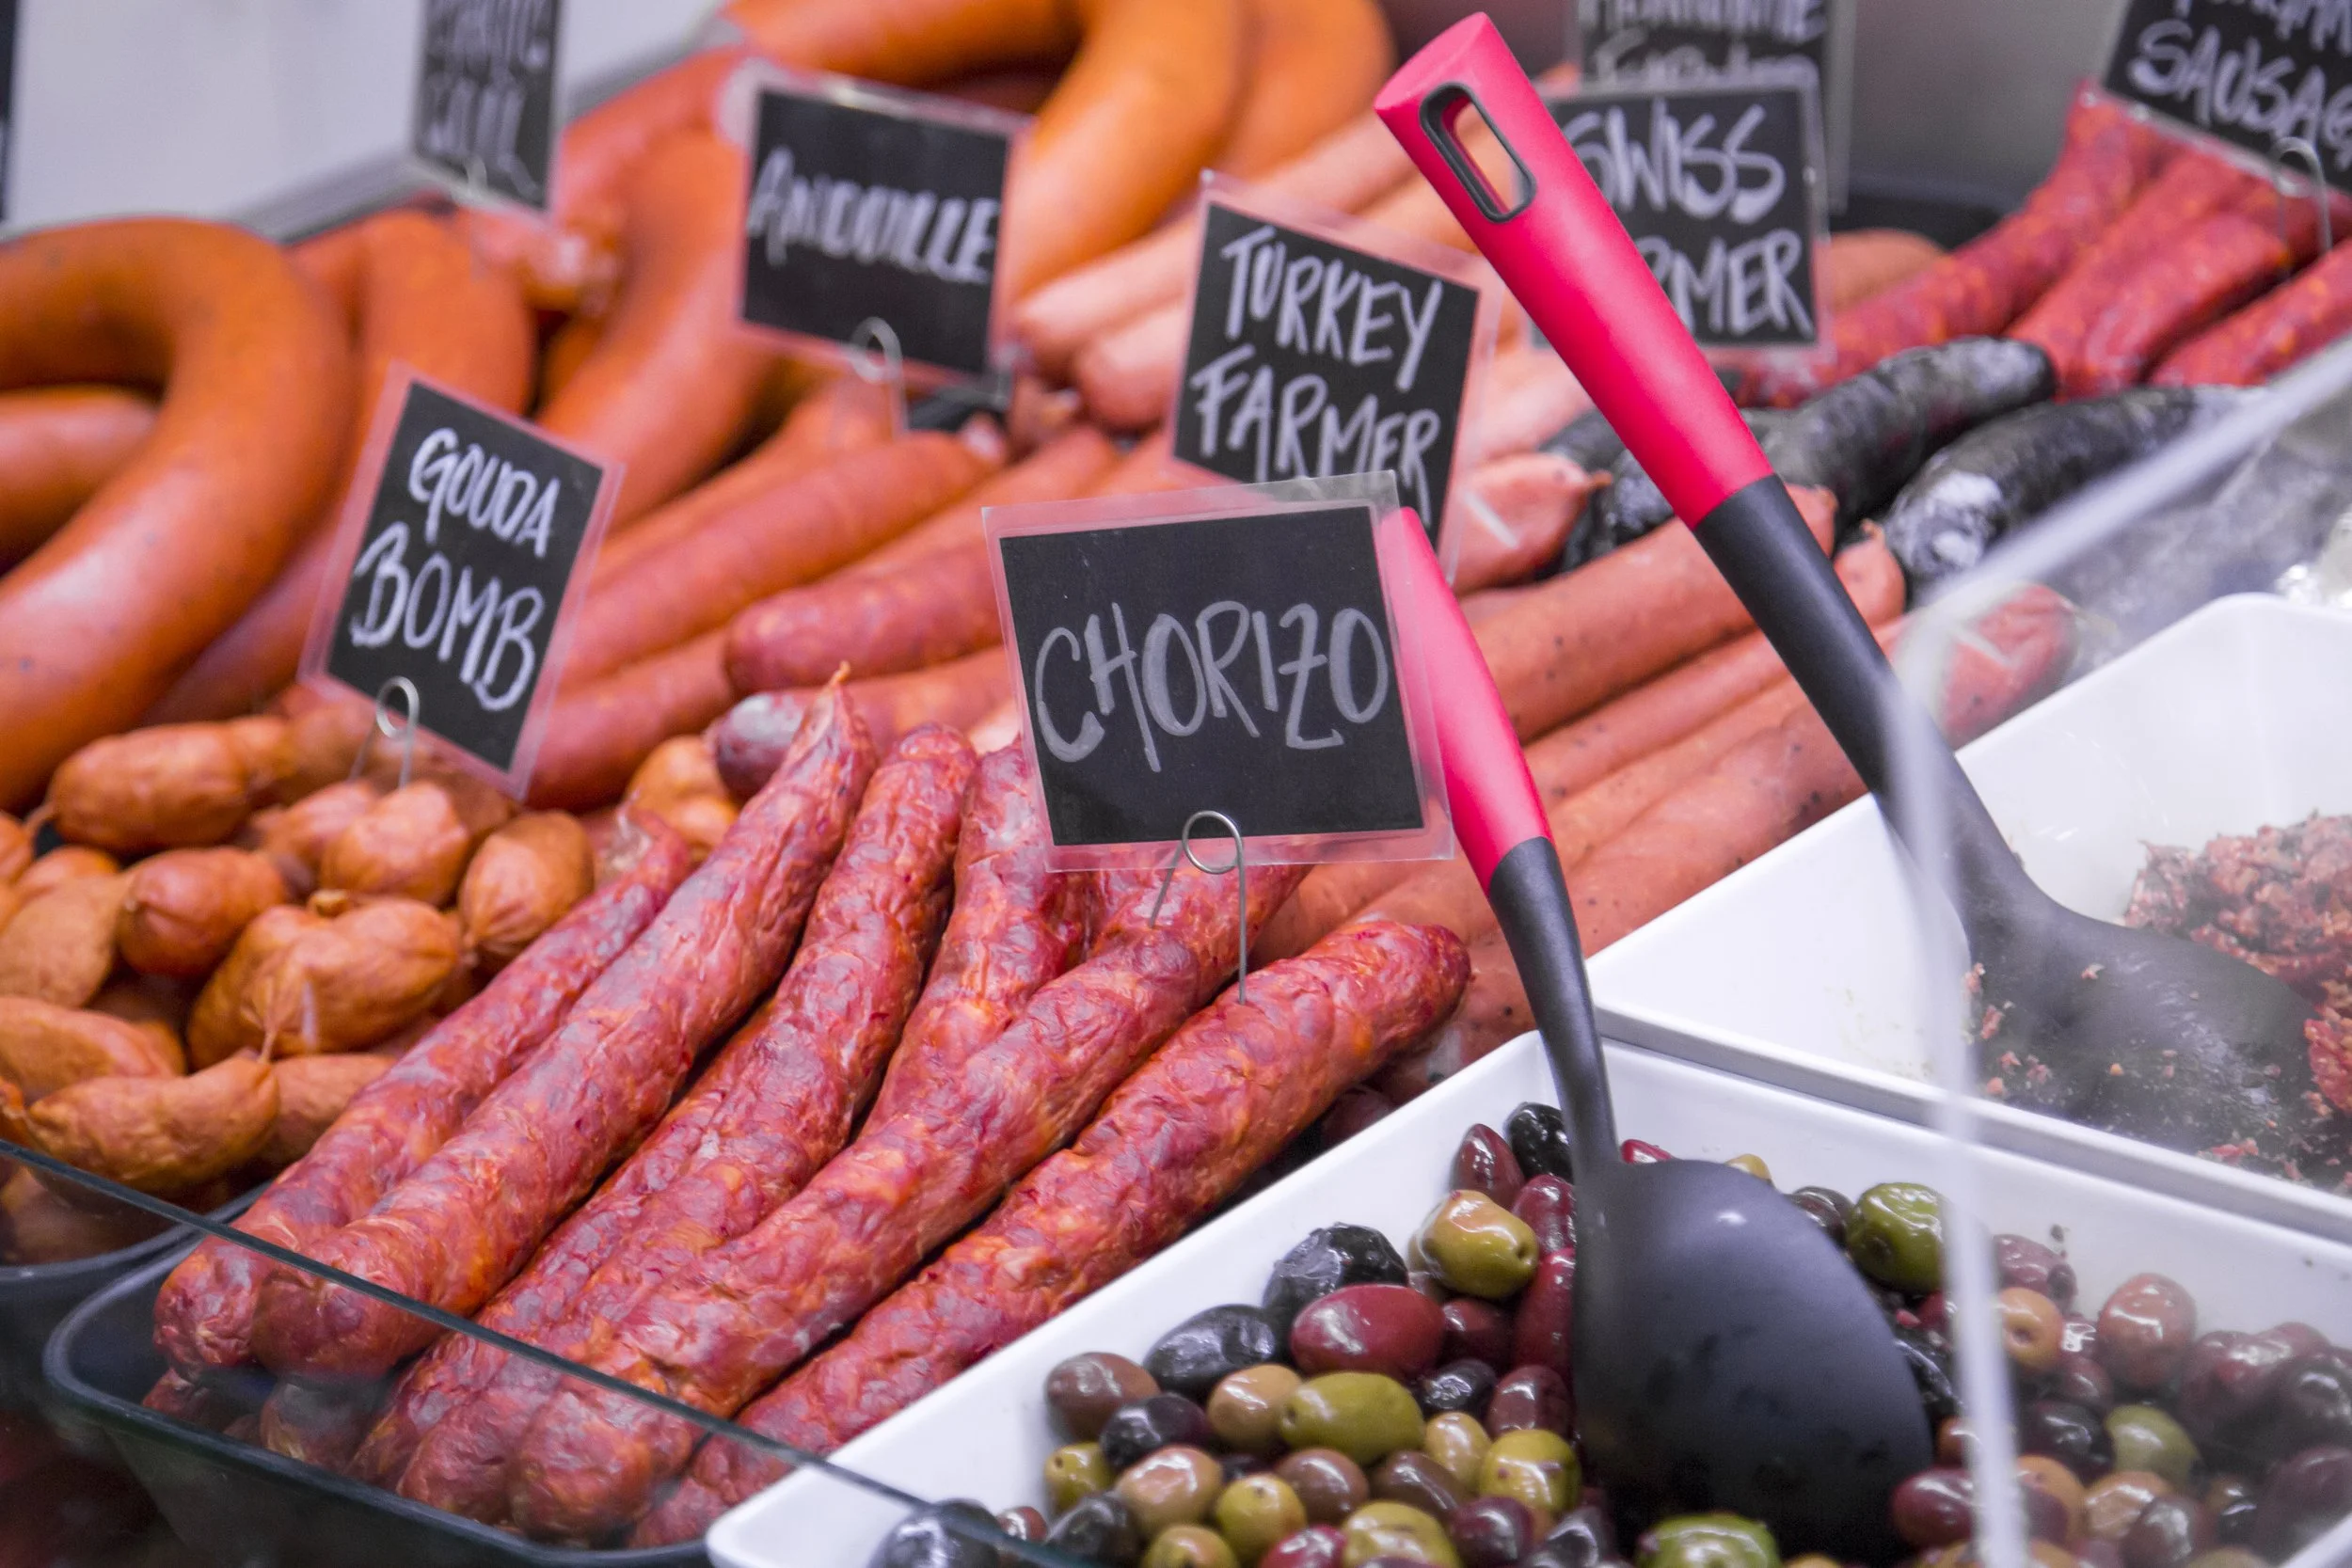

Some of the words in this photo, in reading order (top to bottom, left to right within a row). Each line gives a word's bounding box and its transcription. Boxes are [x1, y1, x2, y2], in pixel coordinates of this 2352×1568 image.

[1566, 98, 1786, 224] SWISS
[1220, 225, 1444, 393] TURKEY
[1637, 229, 1816, 338] MER
[408, 426, 561, 559] GOUDA
[1189, 343, 1440, 529] FARMER
[350, 520, 545, 711] BOMB
[1036, 600, 1389, 772] CHORIZO
